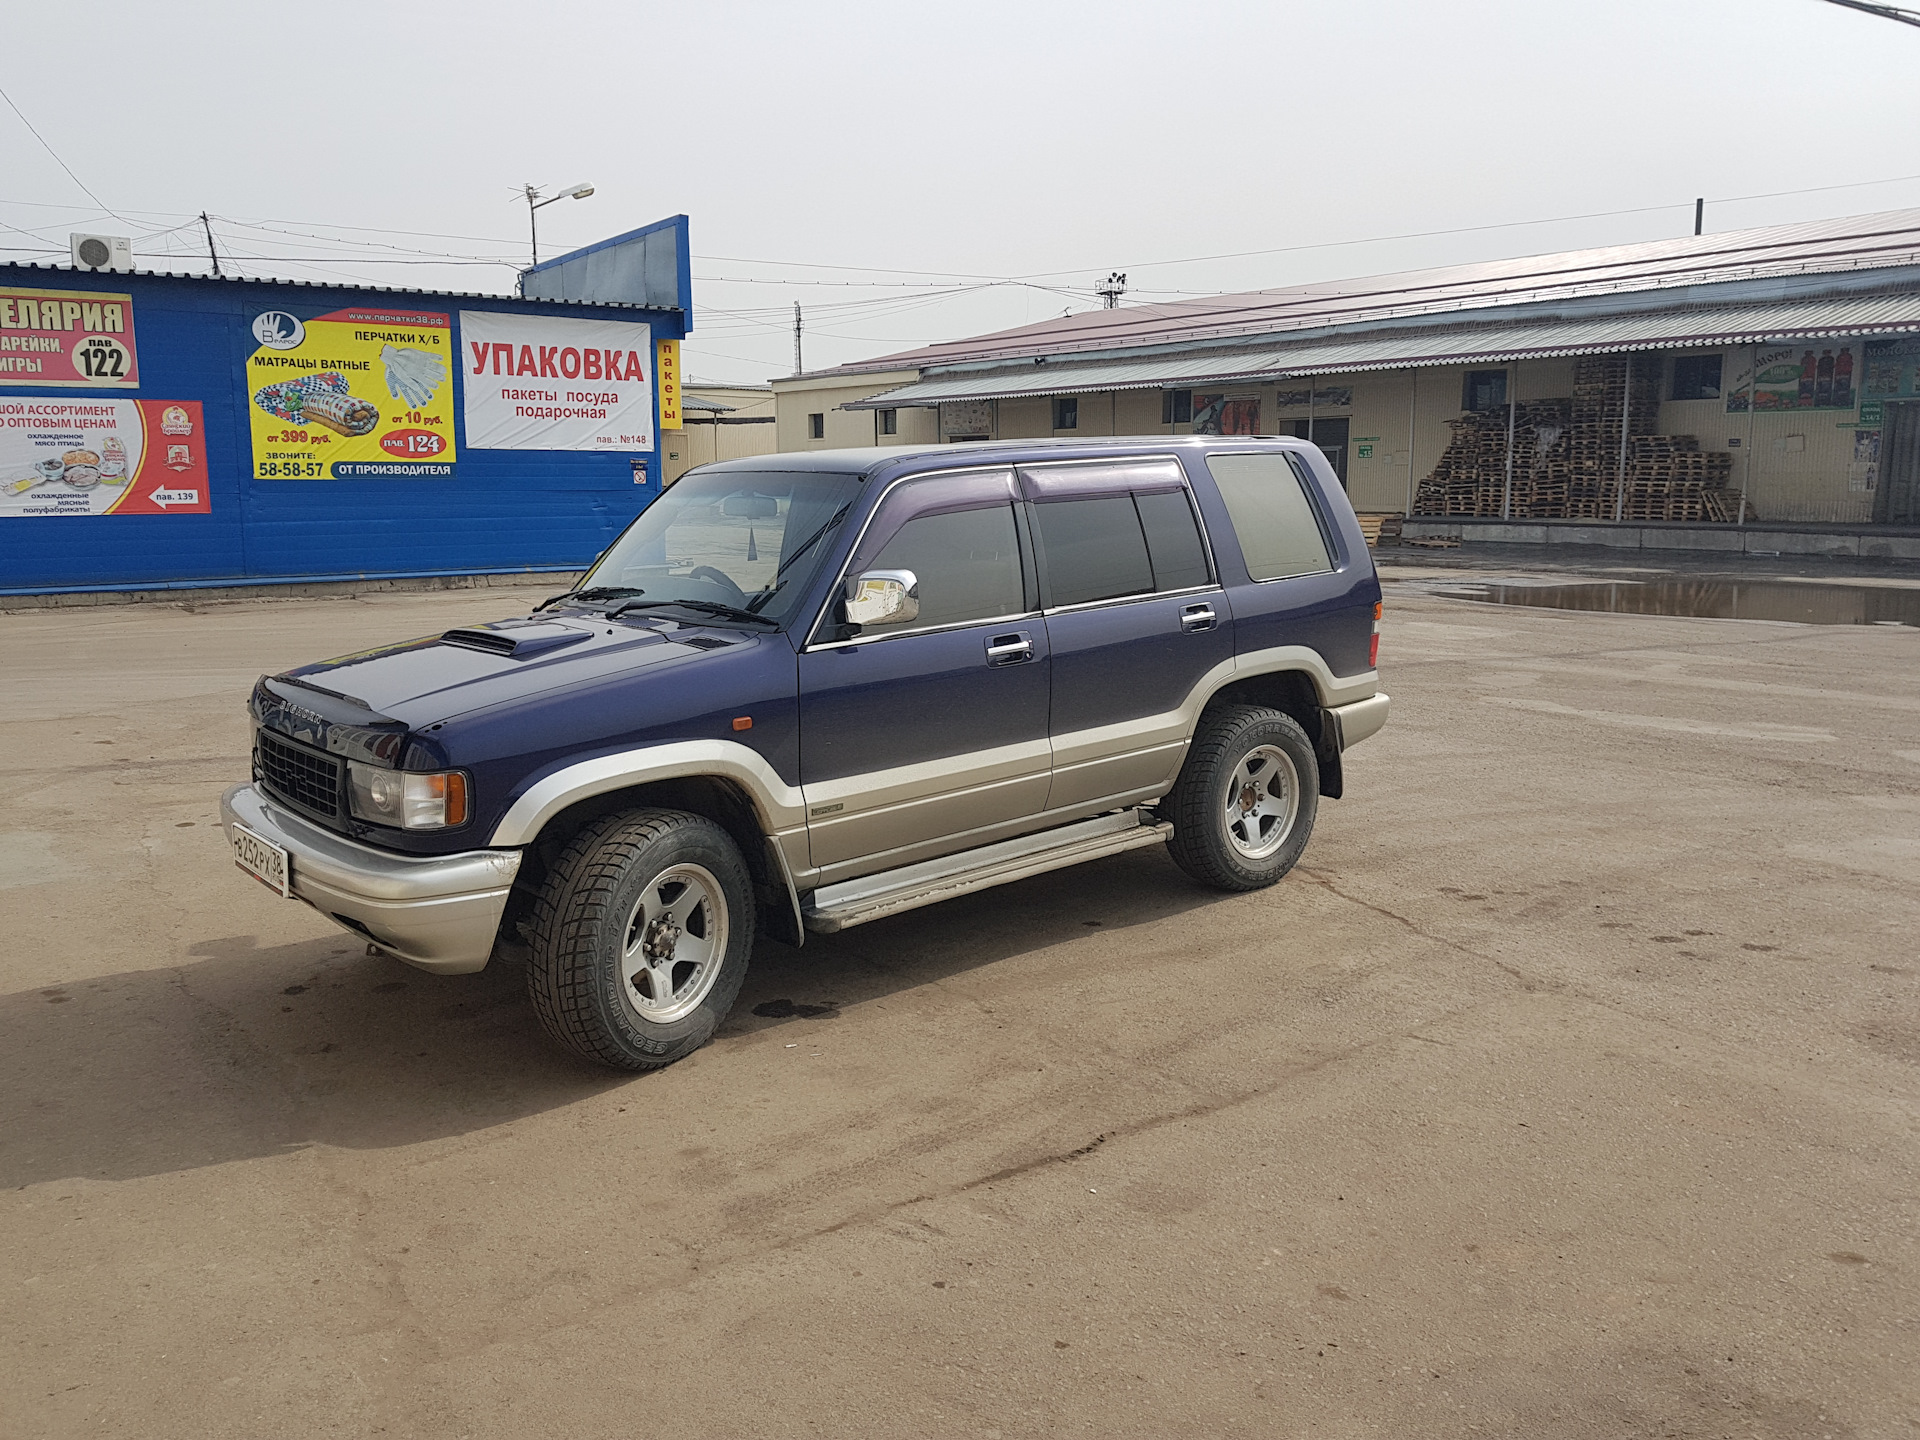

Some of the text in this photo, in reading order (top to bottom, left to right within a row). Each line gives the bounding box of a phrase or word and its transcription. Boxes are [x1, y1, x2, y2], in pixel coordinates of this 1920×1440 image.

[0, 298, 124, 333] ЕЛЯРИЯ
[348, 313, 443, 325] www.перчатки38.рф
[1, 334, 64, 354] АРЕЙКИ,
[88, 339, 113, 347] ПАВ
[355, 331, 440, 346] ПЕРЧАТКИ Х/Б
[0, 357, 42, 373] ИГРЫ
[79, 348, 124, 377] 122
[254, 356, 370, 371] МАТРАЦЫ ВАТНЫЕ
[470, 341, 644, 382] УПАКОВКА
[663, 345, 676, 419] пакеты
[501, 389, 619, 405] пакеты посуда
[28, 405, 115, 416] АССОРТИМЕНТ
[516, 406, 606, 421] подарочная
[7, 417, 71, 428] ОПТОВЫМ
[74, 419, 117, 430] ЦЕНАМ
[405, 411, 421, 424] 10
[424, 415, 443, 426] руб.
[267, 430, 331, 444] от 399 руб.
[383, 435, 439, 453] ПАВ. 124
[620, 435, 646, 444] №148
[265, 452, 316, 460] ЗВОНИТЕ:
[259, 462, 324, 477] 58-58-57
[338, 465, 450, 476] ОТ ПРОИЗВОДИТЕЛЯ
[23, 506, 90, 514] полуфабрикаты
[272, 851, 283, 875] 38
